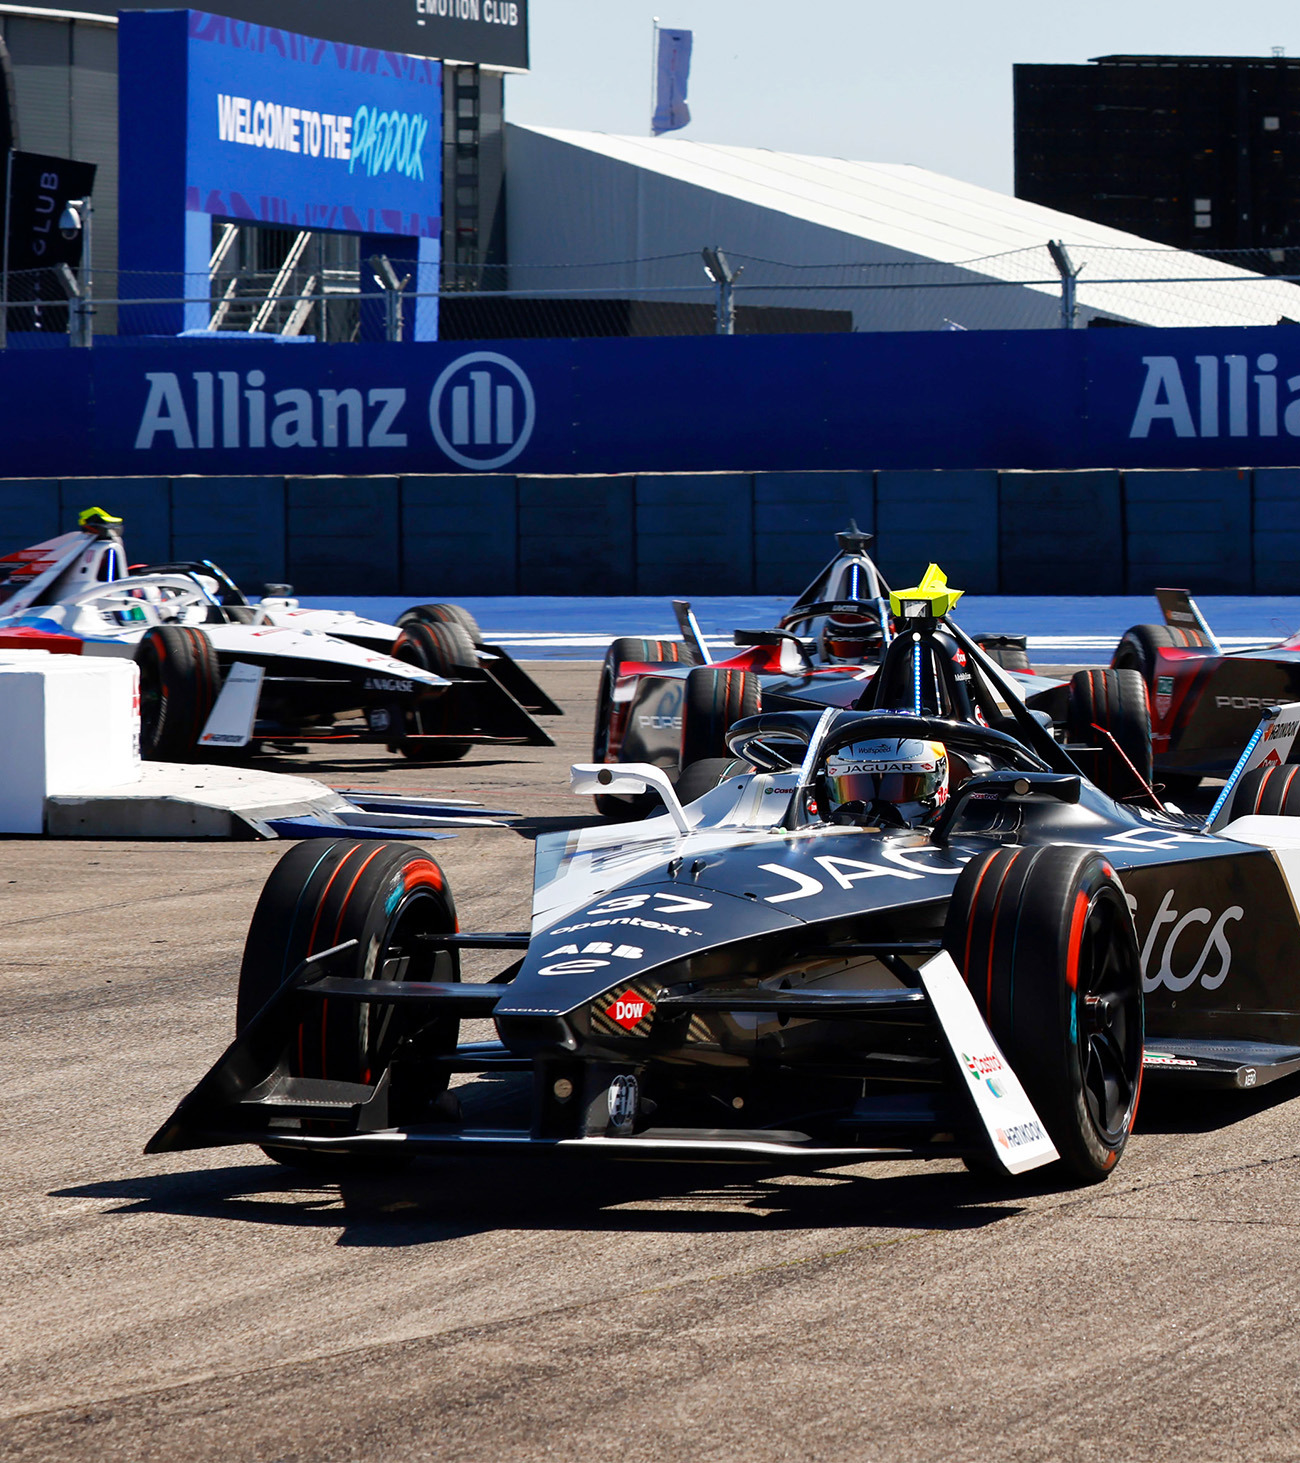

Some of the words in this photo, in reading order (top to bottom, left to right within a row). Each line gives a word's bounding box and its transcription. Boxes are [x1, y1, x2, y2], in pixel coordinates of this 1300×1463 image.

[483, 0, 518, 26] CLUB
[217, 93, 300, 154] WELCOME
[300, 110, 322, 158] TO
[321, 114, 353, 160] THE
[349, 104, 428, 182] PADDOCK
[134, 369, 407, 449] Allianz
[638, 715, 682, 730] PORS
[843, 763, 913, 774] JAGUAR
[586, 892, 714, 916] 37
[541, 941, 644, 959] ABB
[1141, 888, 1245, 993] tcs
